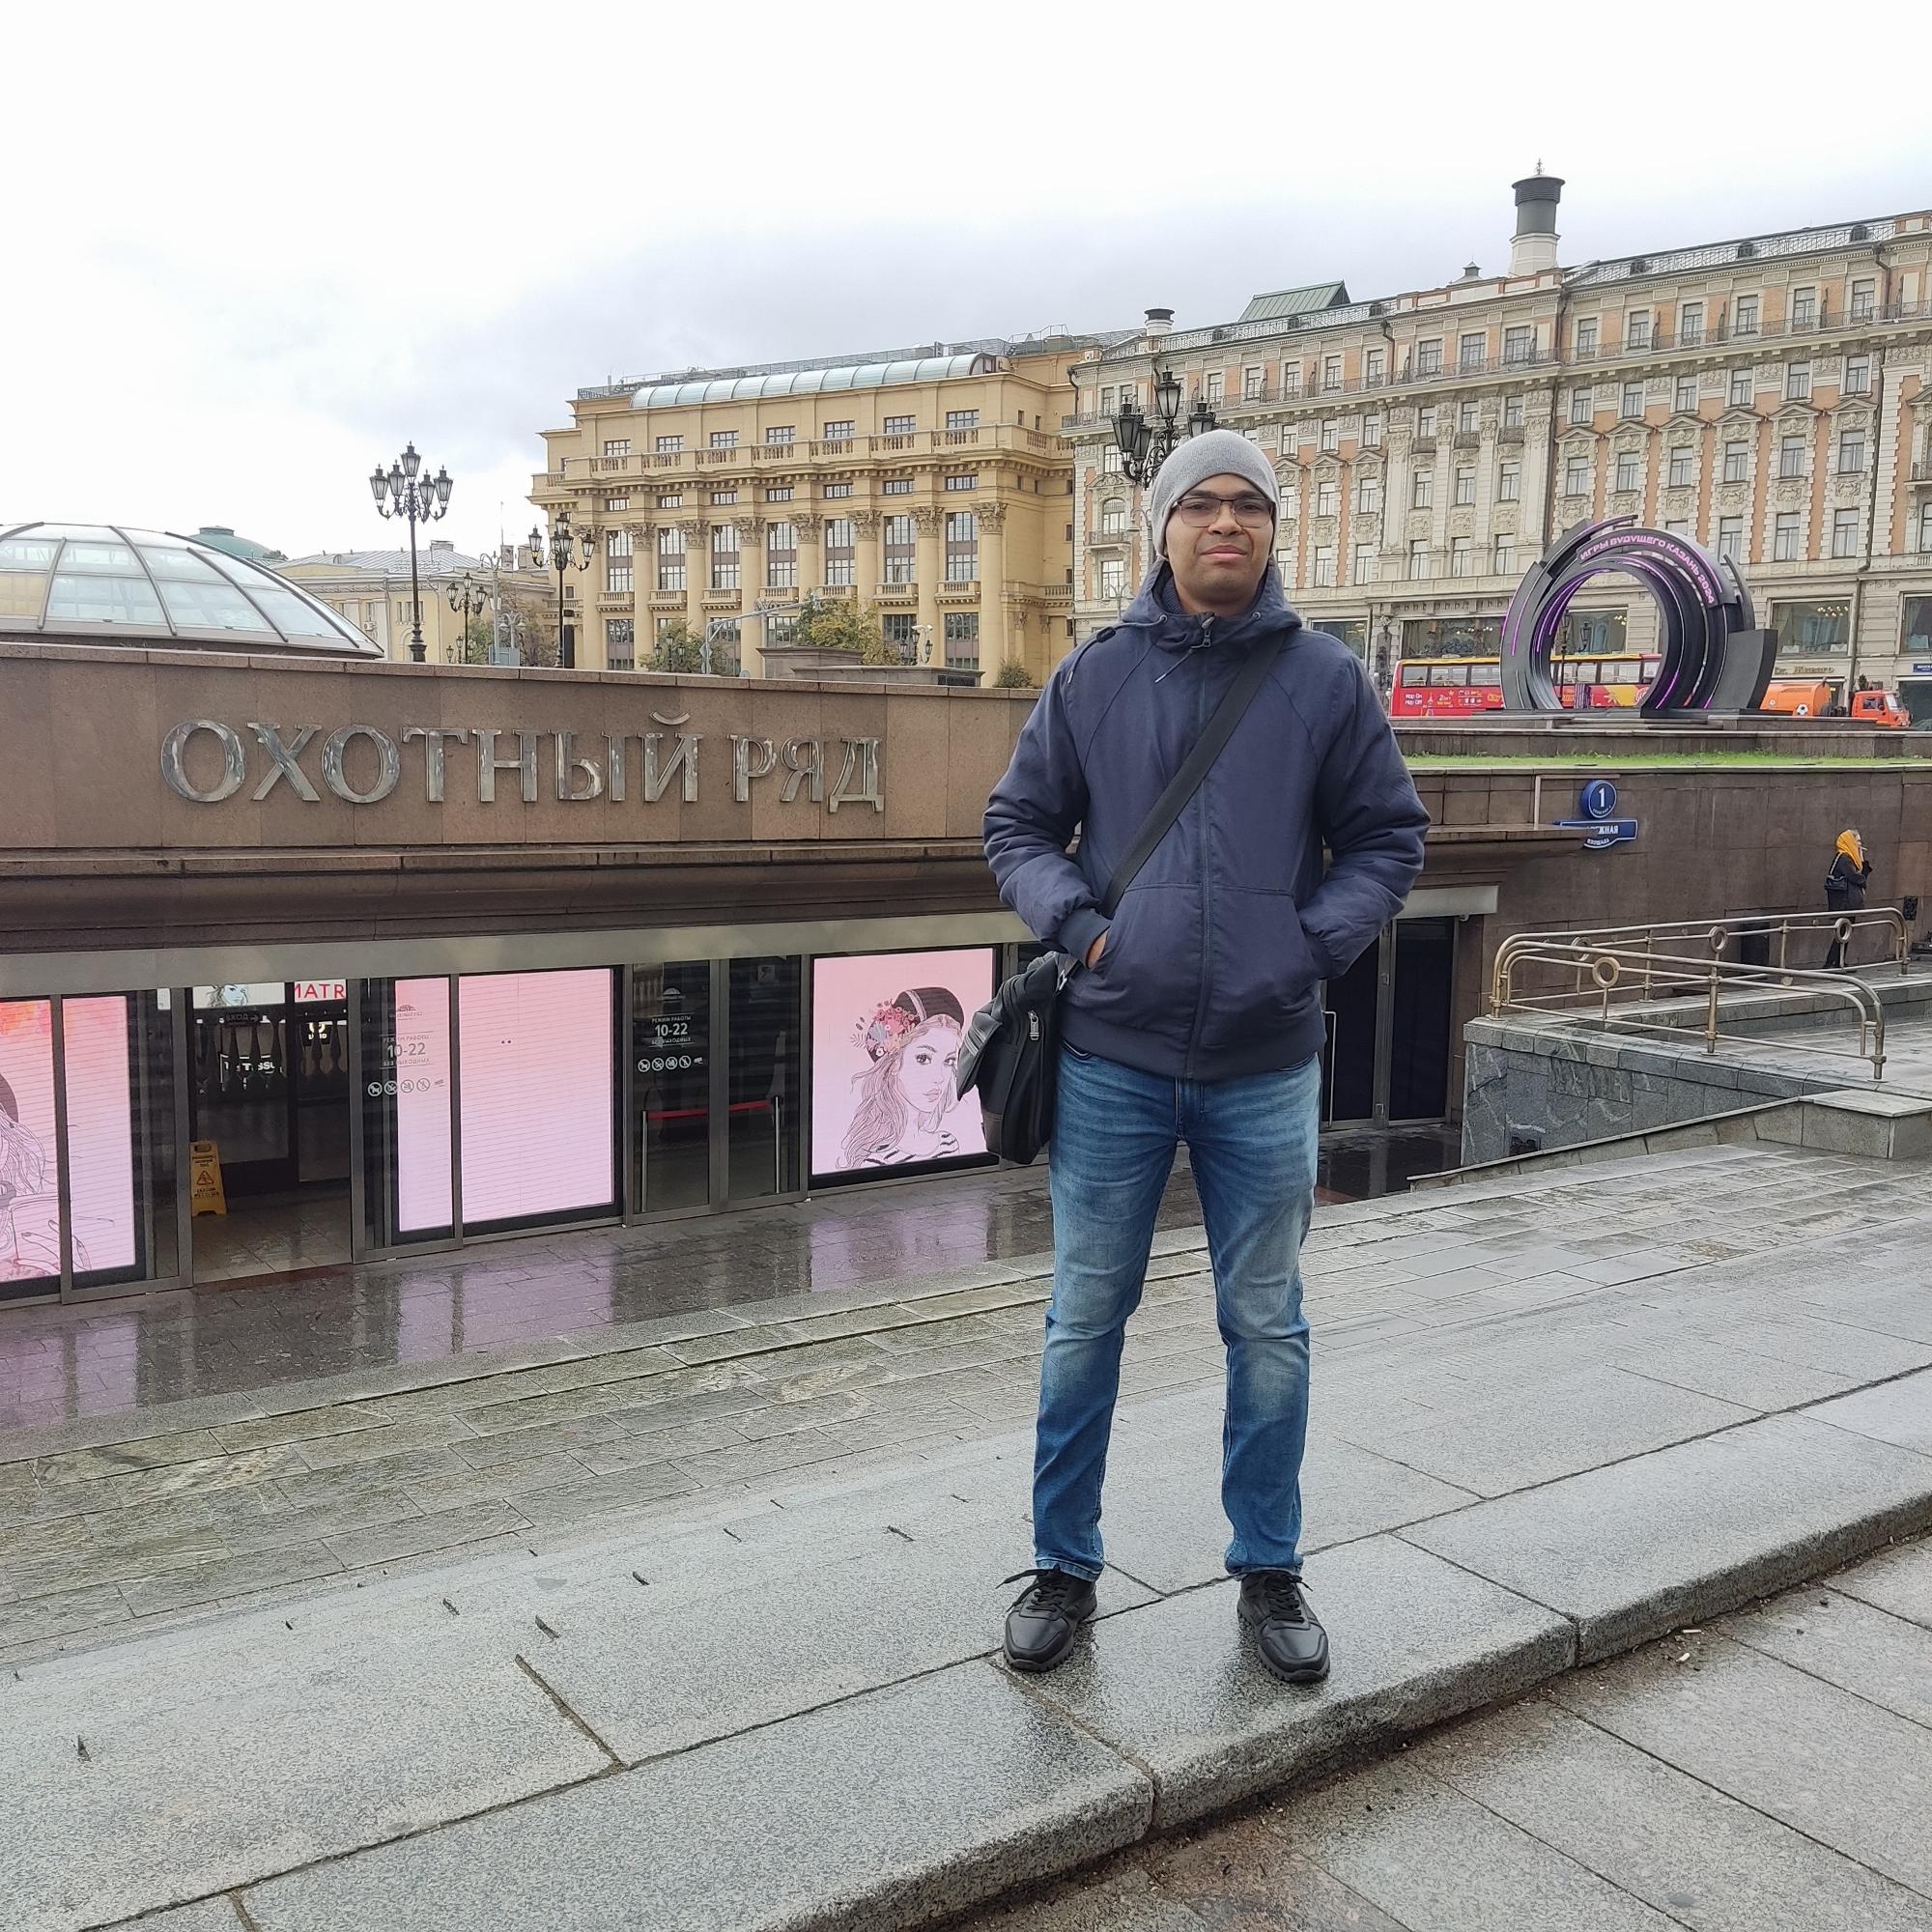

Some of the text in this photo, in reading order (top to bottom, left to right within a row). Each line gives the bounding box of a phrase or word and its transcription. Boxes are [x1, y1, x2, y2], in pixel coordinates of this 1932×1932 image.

[1579, 534, 1716, 604] ИГРЫ БУДУЩЕГО КАЗАНЬ 2024
[160, 710, 885, 813] ОХОТНЫЙ РЯД
[1598, 787, 1605, 808] 1
[654, 1022, 688, 1037] 10-22
[386, 1042, 426, 1059] 10-22
